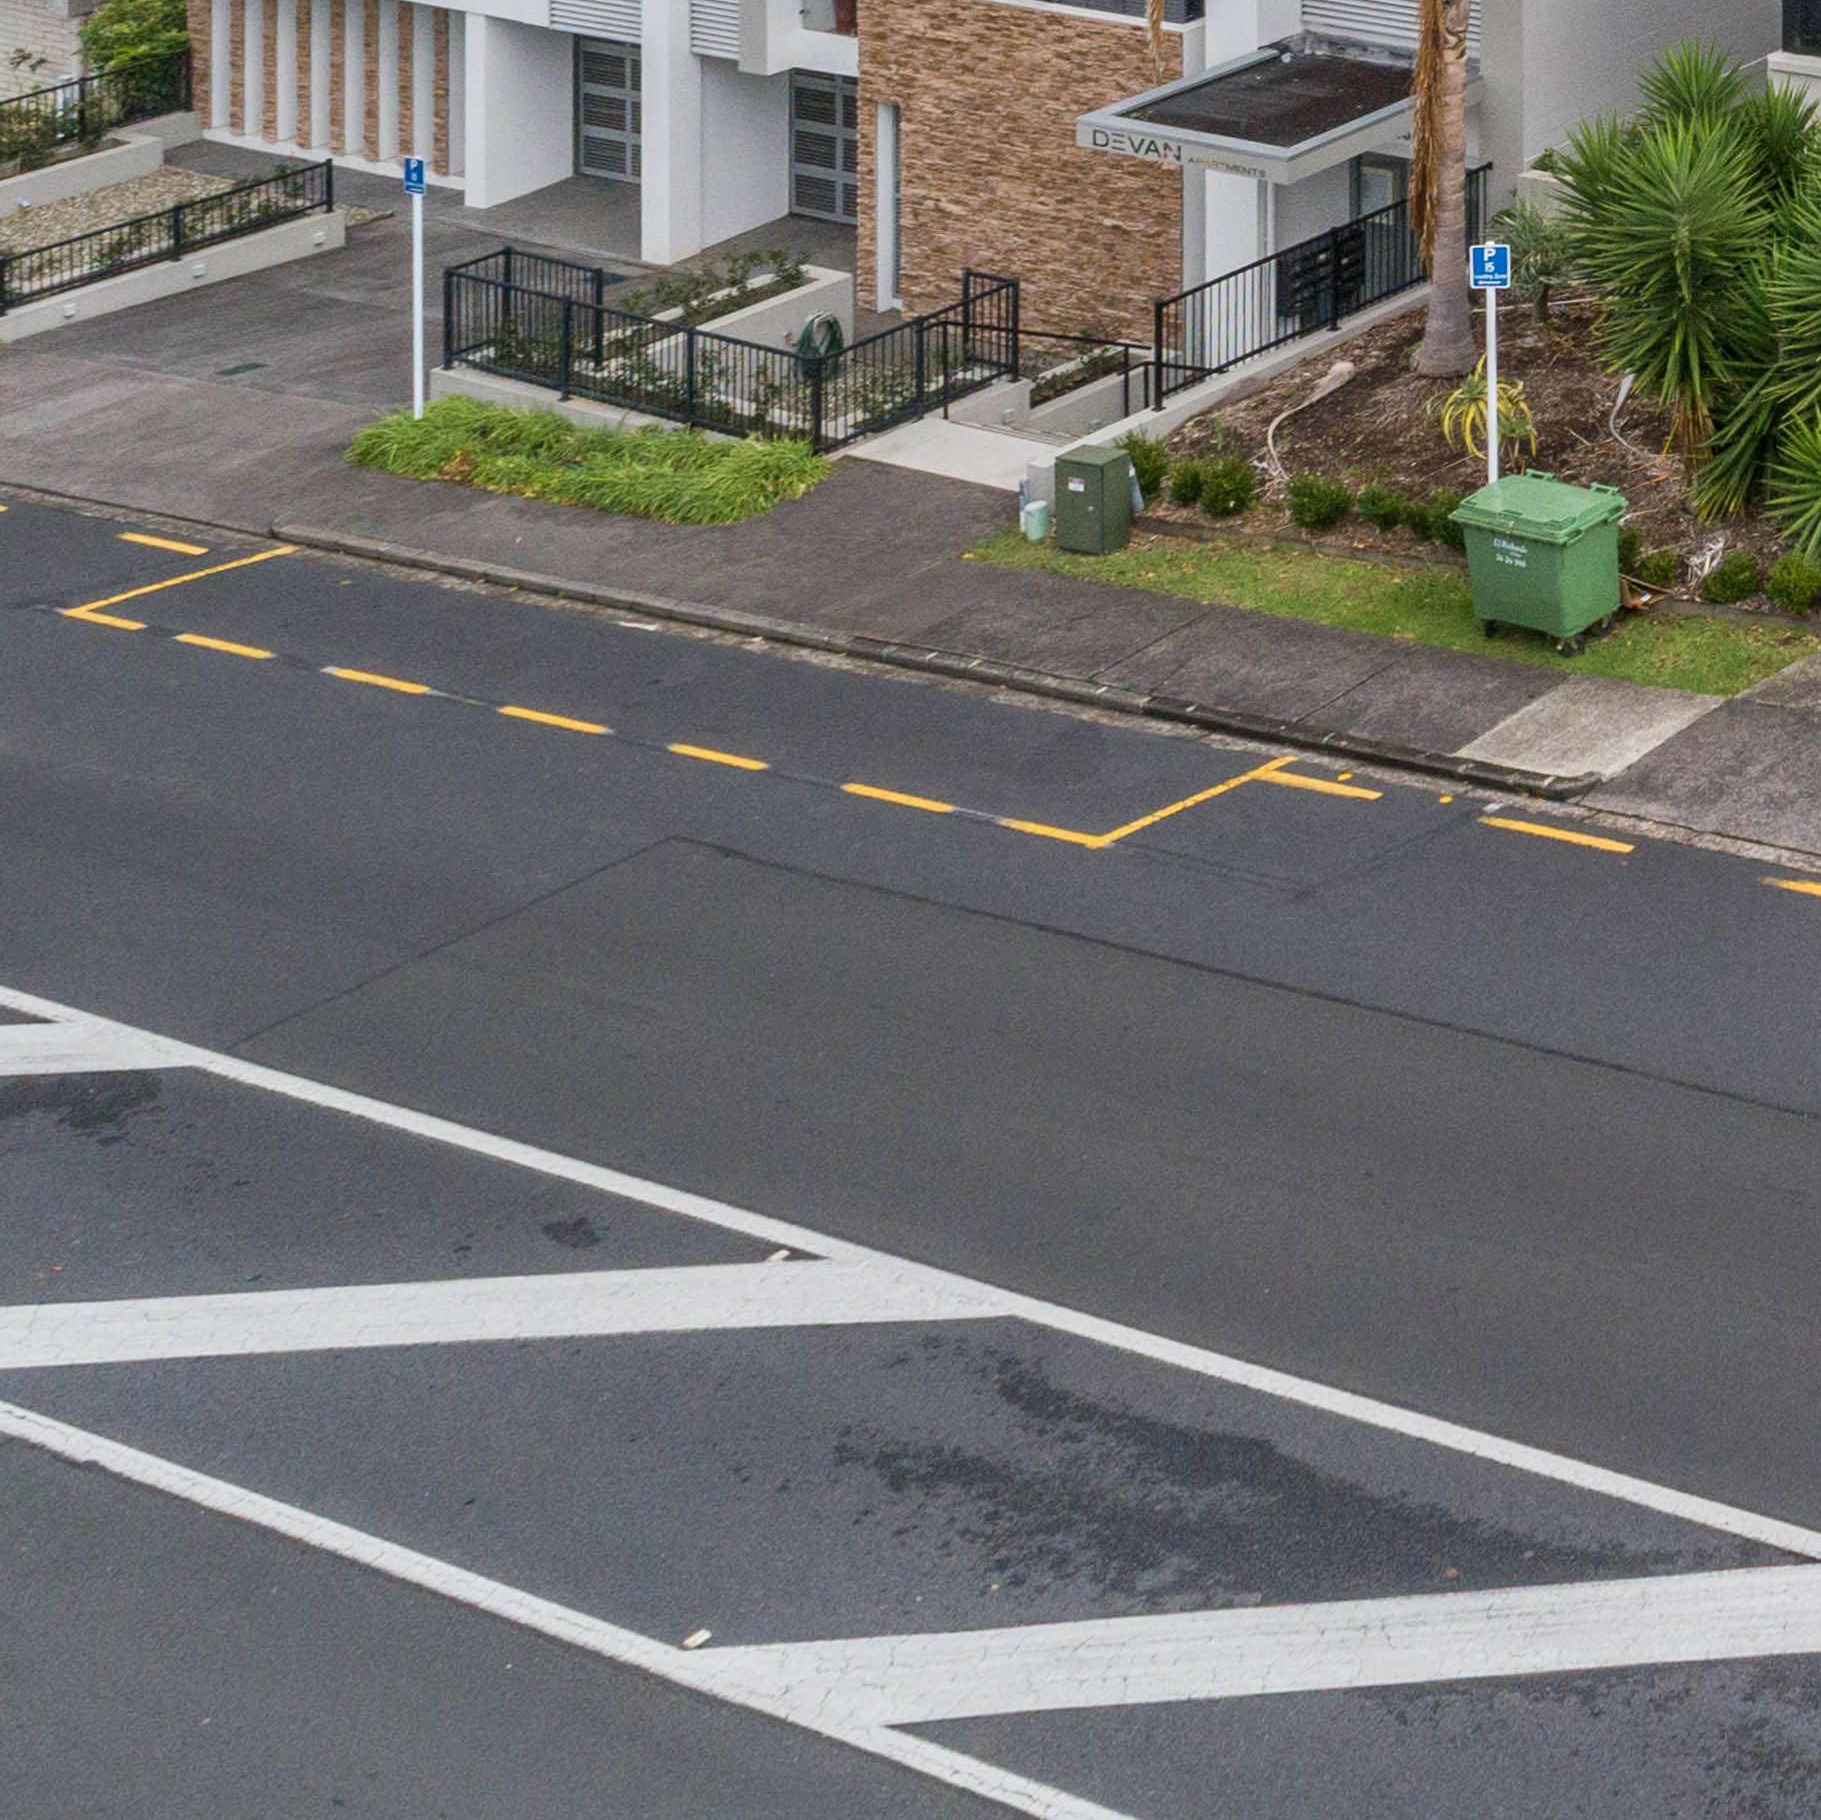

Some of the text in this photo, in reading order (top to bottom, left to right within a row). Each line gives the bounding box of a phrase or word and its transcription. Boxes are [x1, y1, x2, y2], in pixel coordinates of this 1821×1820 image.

[1092, 129, 1267, 178] DEVAN APARTMENTS
[1484, 248, 1497, 262] P
